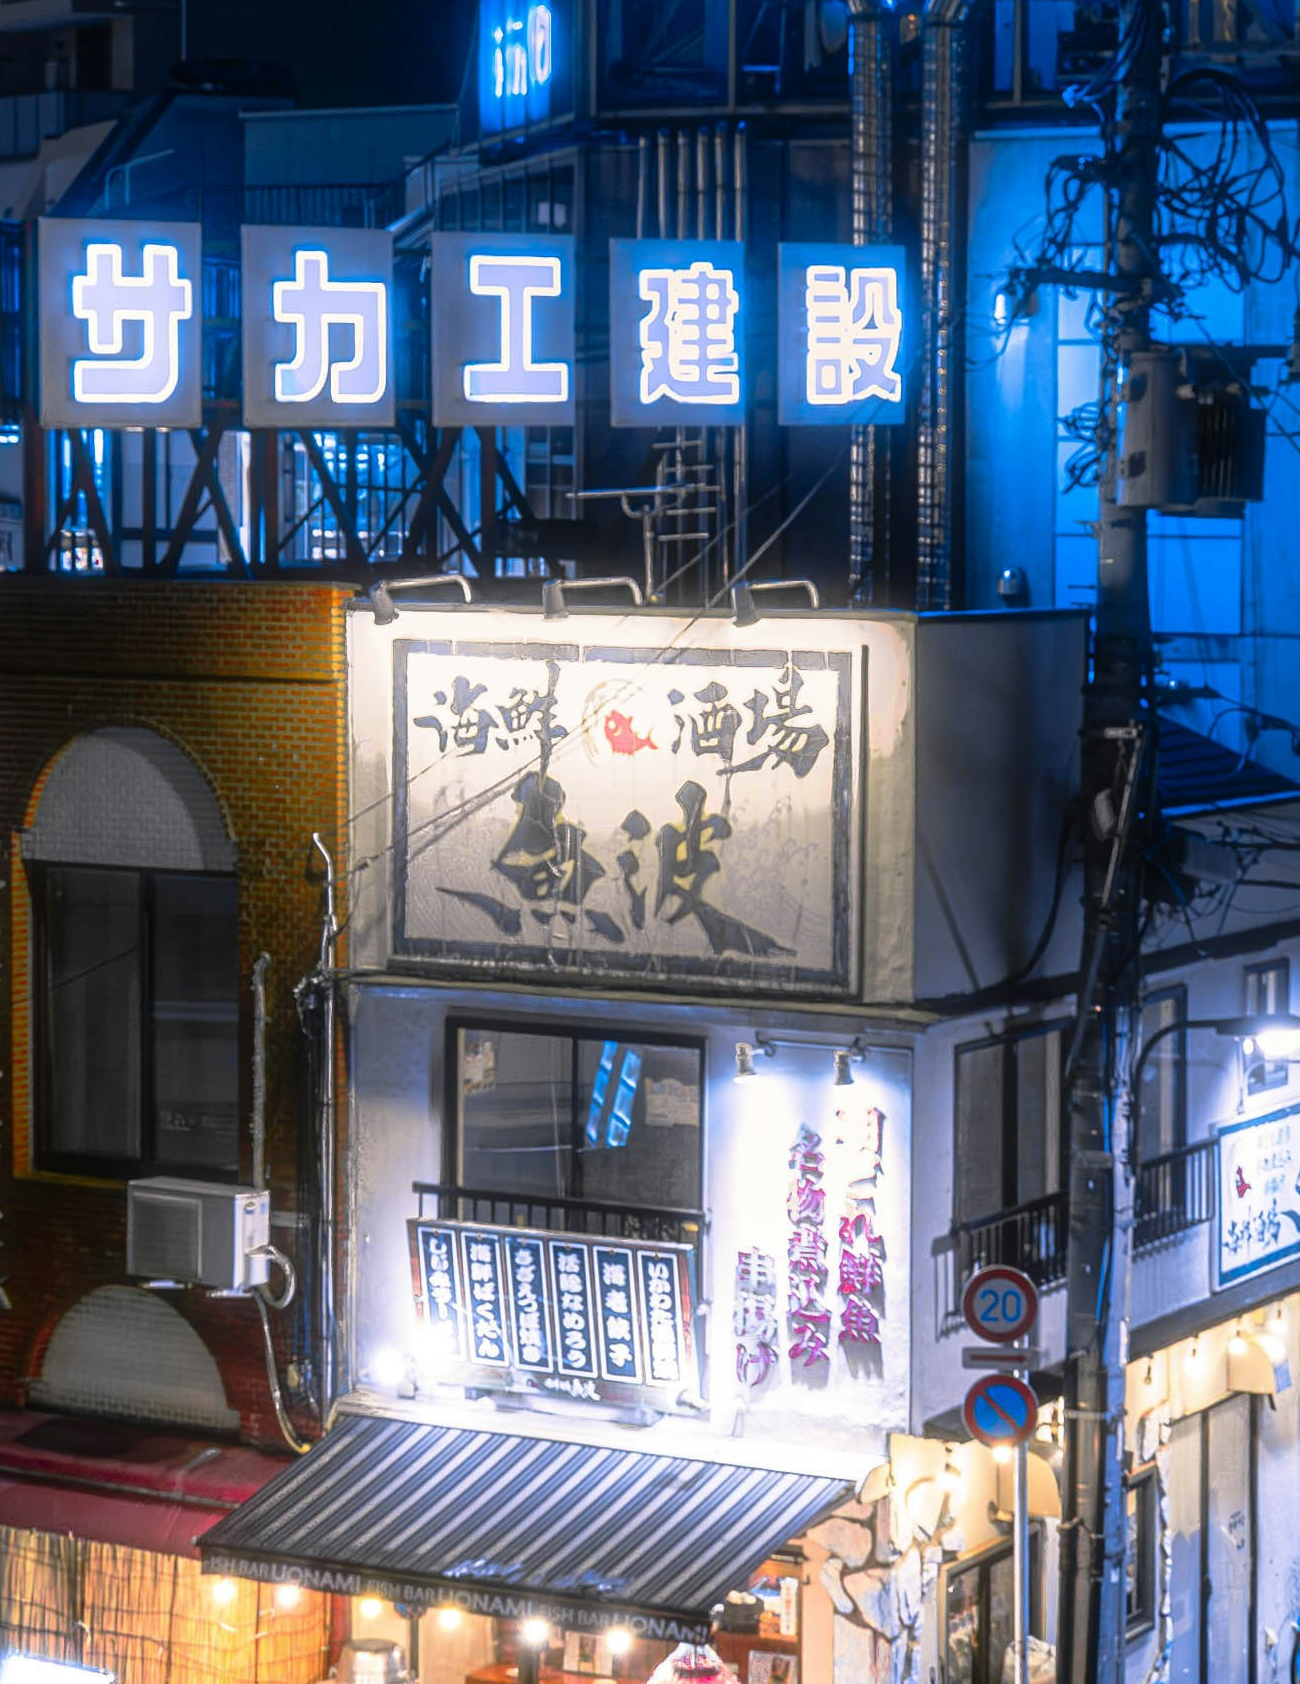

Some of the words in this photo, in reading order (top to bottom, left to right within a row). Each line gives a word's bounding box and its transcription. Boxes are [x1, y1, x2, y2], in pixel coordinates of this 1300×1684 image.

[72, 243, 903, 405] サカエ建設
[413, 659, 570, 772] 海鮮
[666, 664, 830, 779] 酒場
[435, 769, 799, 957] 魚波
[979, 1289, 1023, 1324] 20
[239, 1560, 270, 1580] BAR
[271, 1563, 362, 1595] UONAMI
[403, 1584, 436, 1604] BAR
